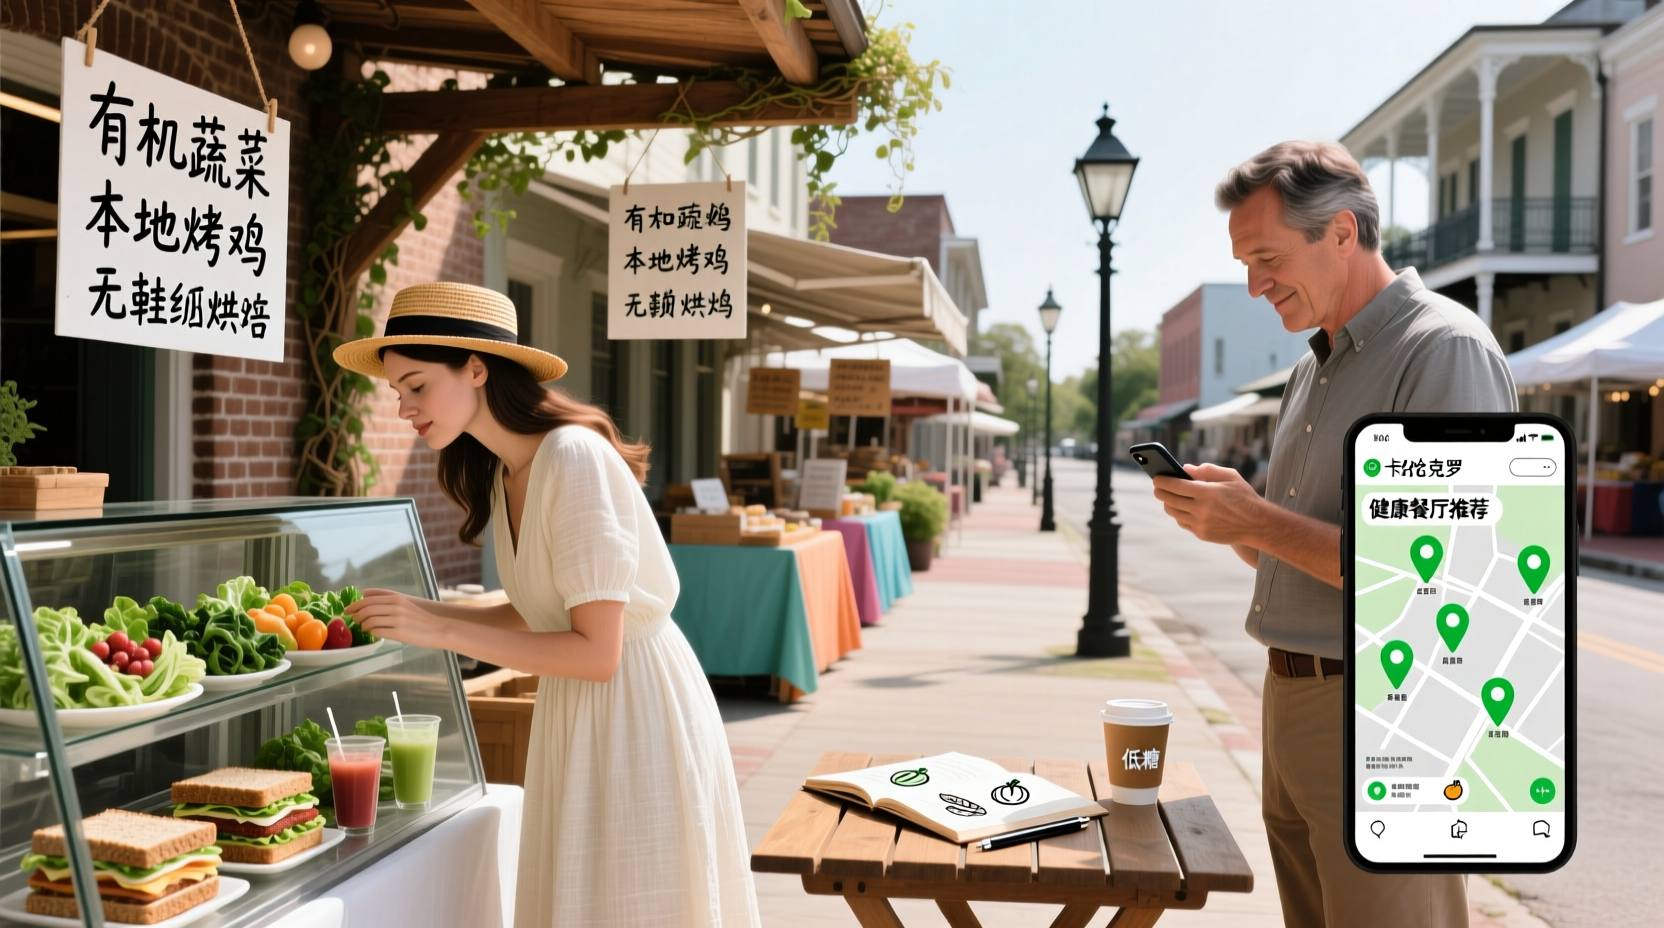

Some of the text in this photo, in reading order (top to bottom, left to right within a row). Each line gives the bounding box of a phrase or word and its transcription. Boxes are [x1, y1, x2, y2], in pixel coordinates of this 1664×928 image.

[89, 81, 270, 199] 有机蔬菜
[85, 179, 266, 277] 本地烤鸡
[624, 243, 728, 275] 本地烤鸡
[1369, 497, 1490, 520] 健康餐厅推荐
[1121, 748, 1160, 770] 低糖
